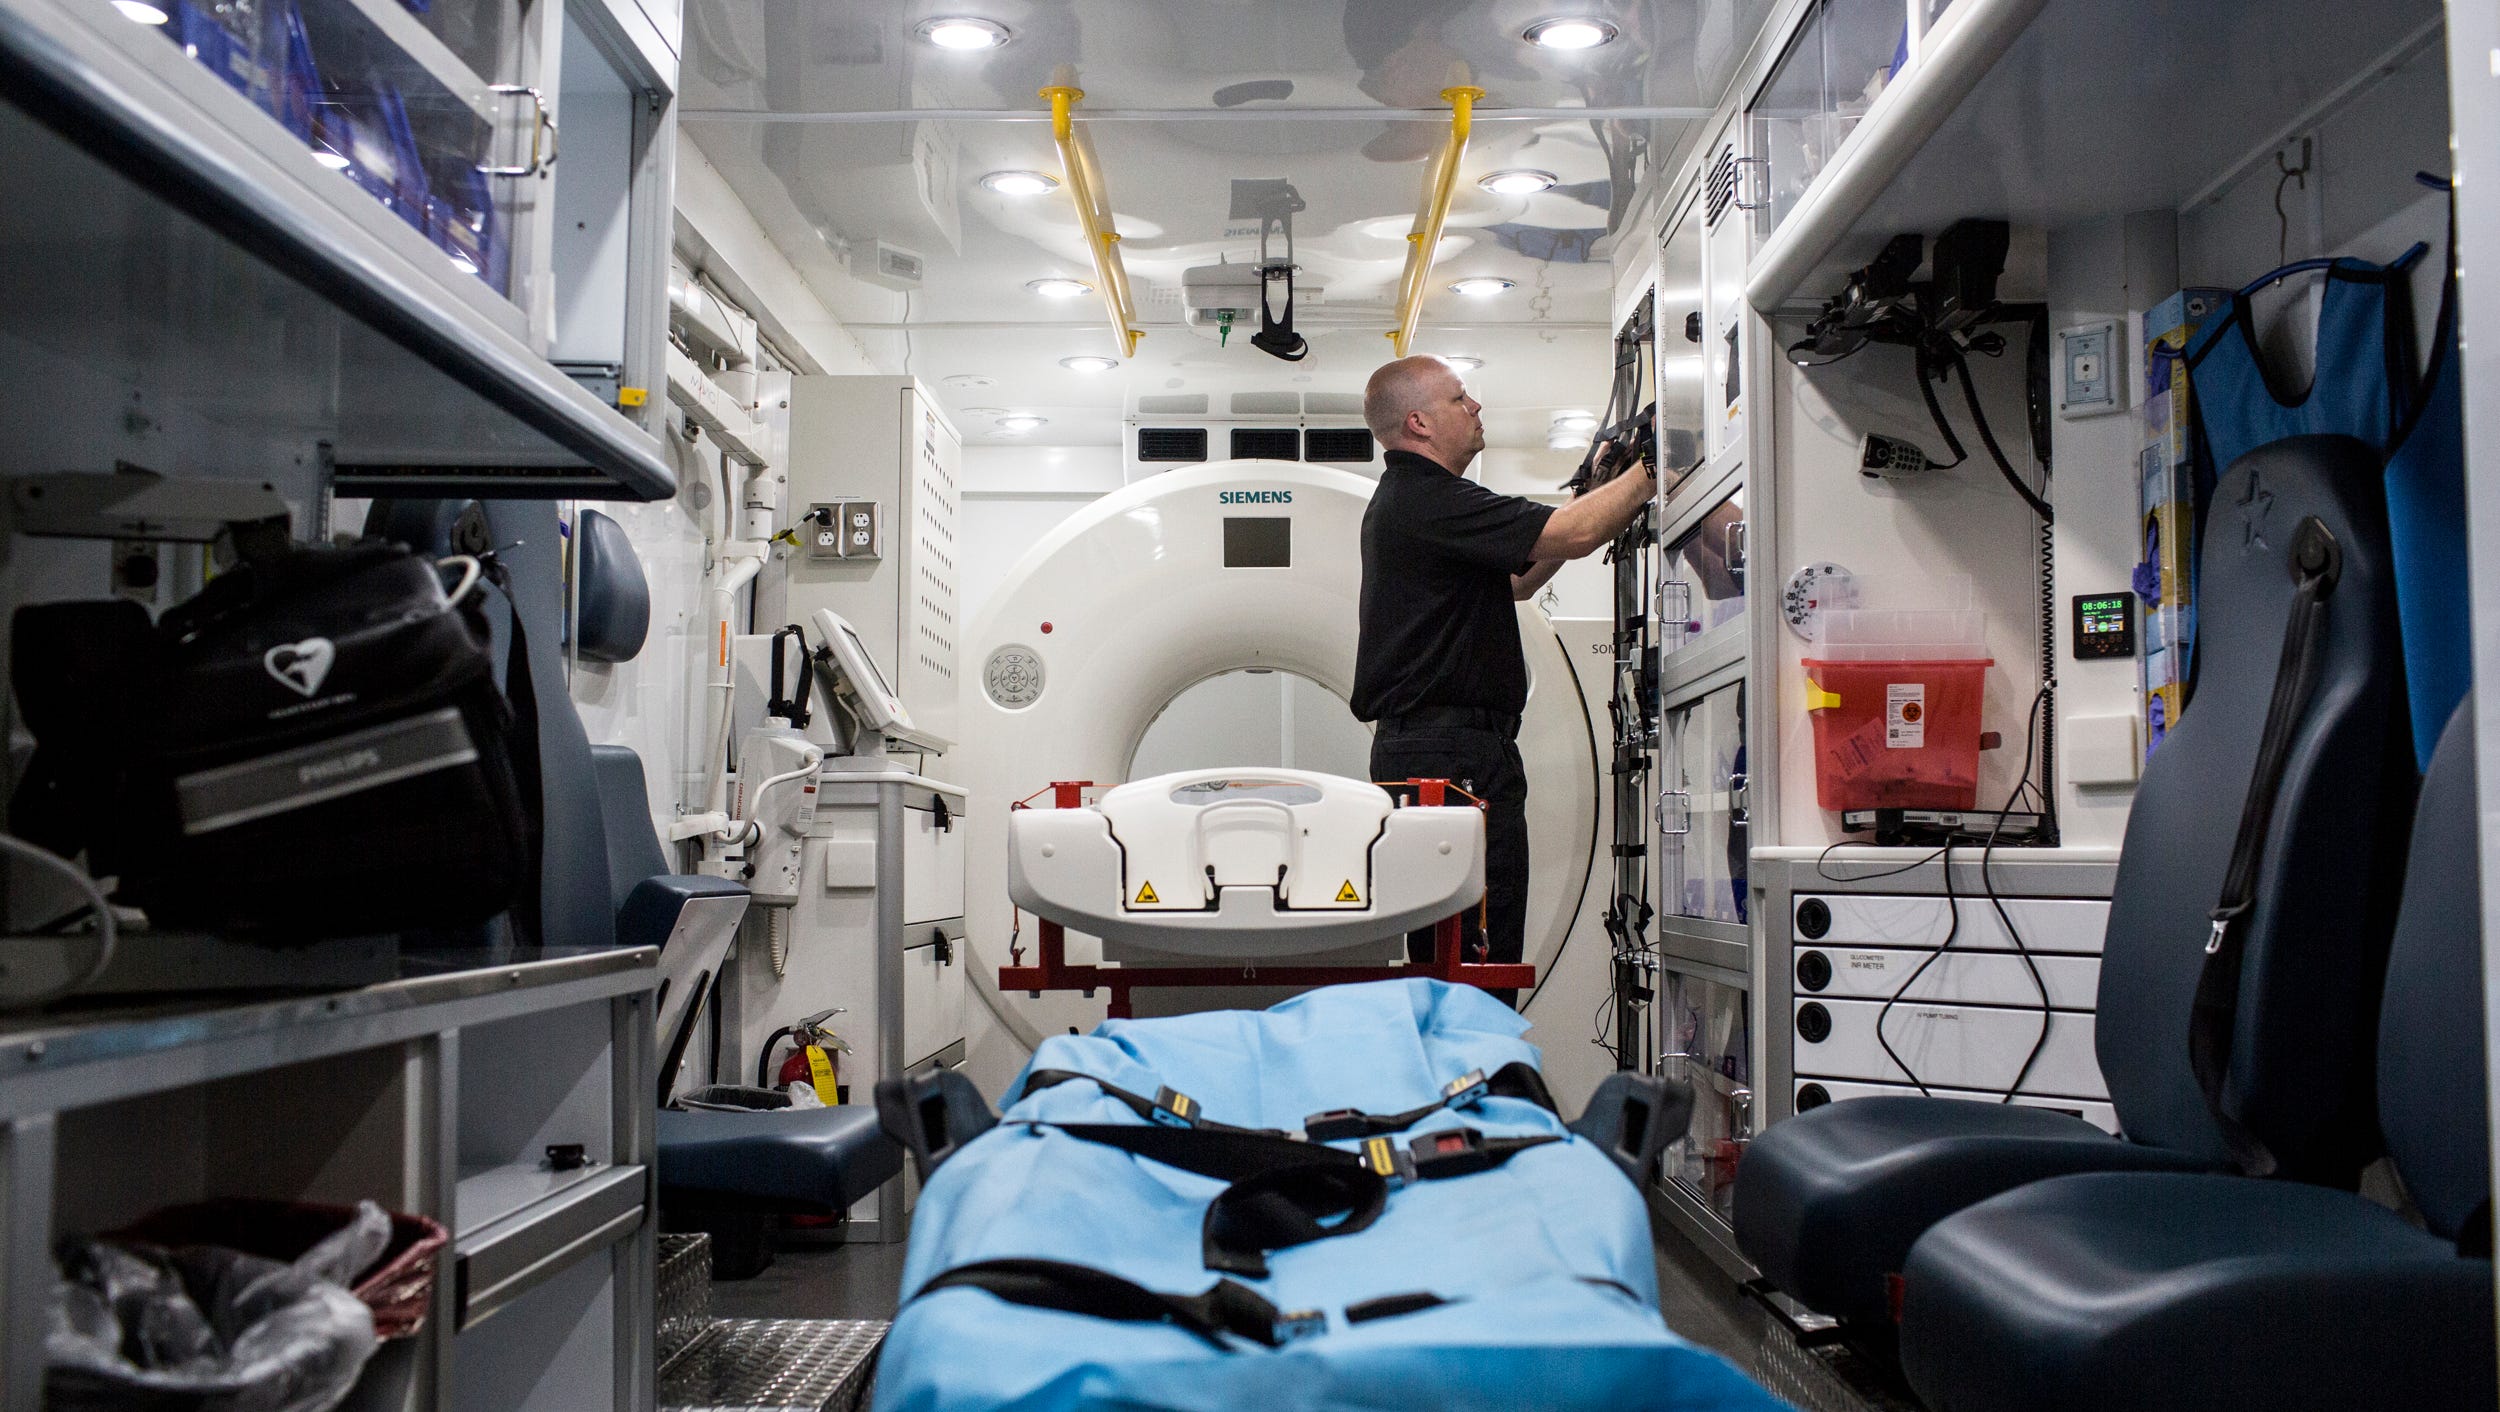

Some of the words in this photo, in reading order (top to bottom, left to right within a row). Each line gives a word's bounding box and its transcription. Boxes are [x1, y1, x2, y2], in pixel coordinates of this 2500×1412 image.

[1219, 491, 1293, 504] SIEMENS
[1805, 568, 1814, 577] 20
[1824, 566, 1833, 575] 40
[1794, 580, 1800, 589] 0
[2082, 600, 2122, 611] 08:06:18
[1863, 962, 1885, 970] METER
